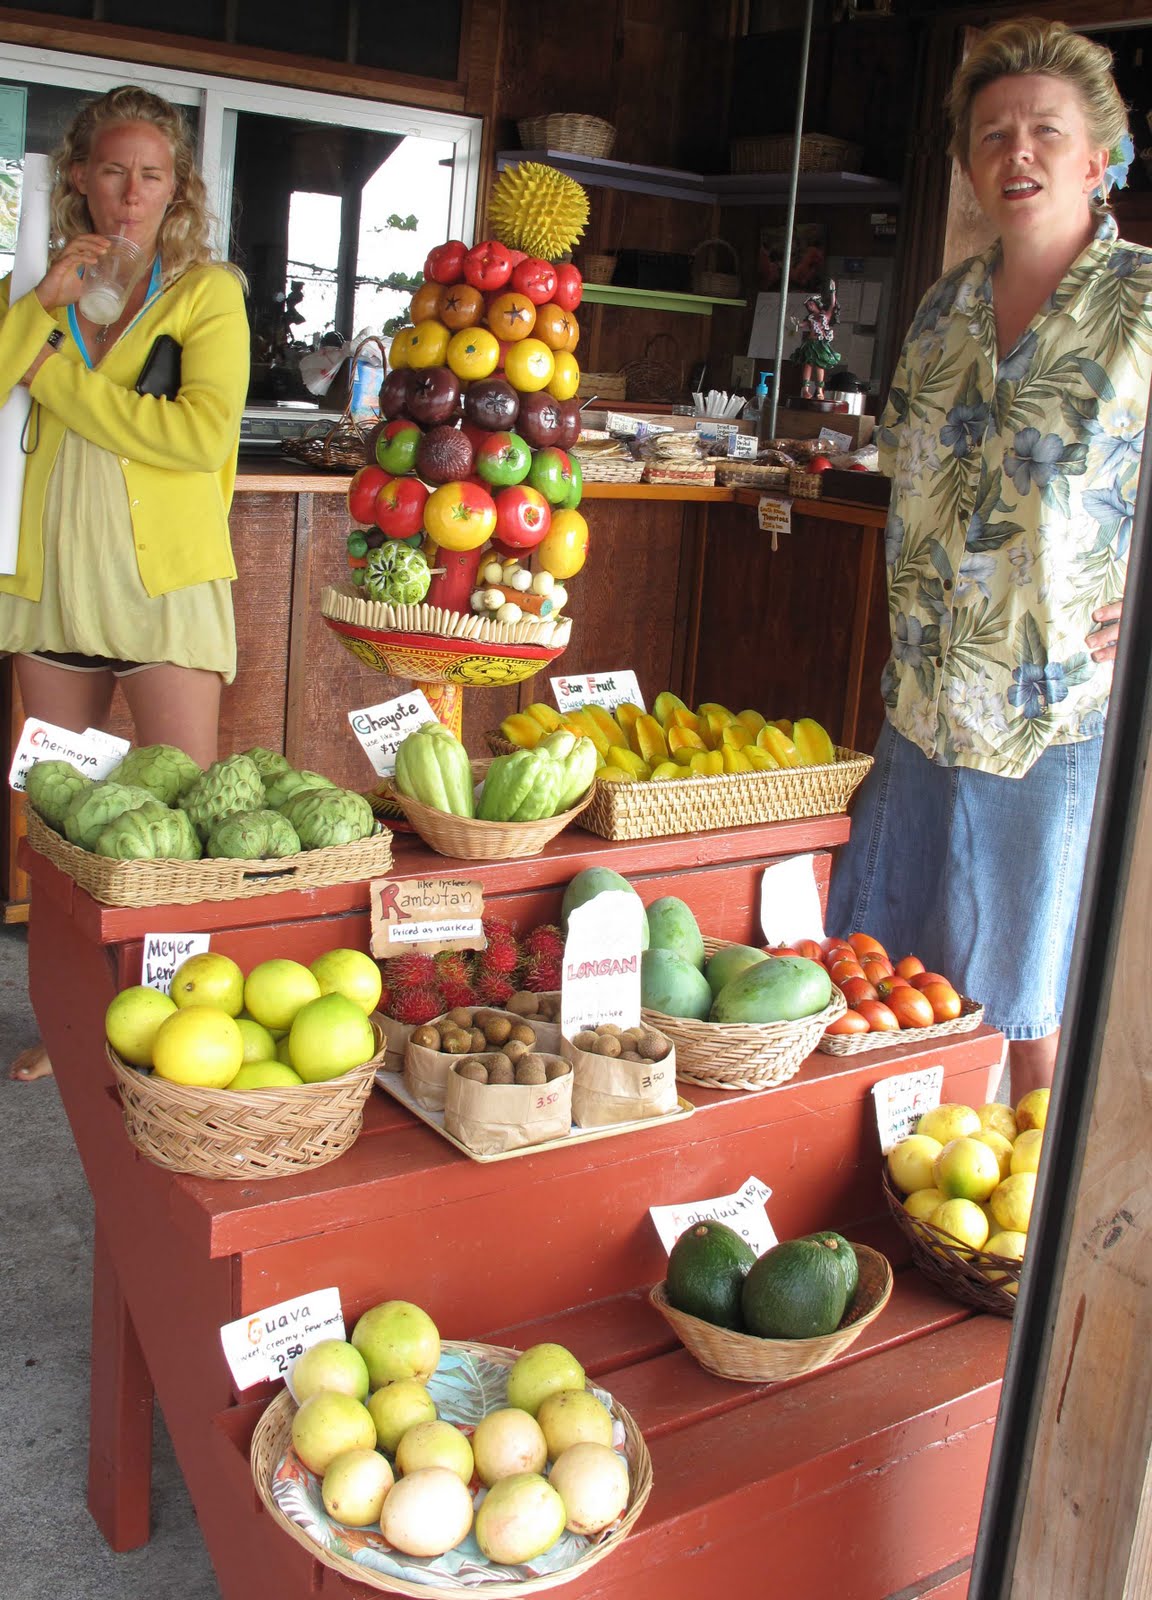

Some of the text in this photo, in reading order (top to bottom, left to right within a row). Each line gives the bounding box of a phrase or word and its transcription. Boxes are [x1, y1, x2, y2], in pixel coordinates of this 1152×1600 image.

[558, 677, 617, 697] Star Fruit
[352, 703, 420, 735] Chayote
[30, 727, 98, 767] Cherimoya
[417, 880, 434, 889] like
[380, 883, 473, 921] Rambutan
[392, 926, 419, 937] Priced
[422, 927, 433, 935] as
[147, 939, 195, 967] Meyer
[146, 963, 176, 984] Lem
[566, 955, 638, 981] LONGAN
[535, 1092, 560, 1109] 3.50
[247, 1305, 312, 1345] Guava
